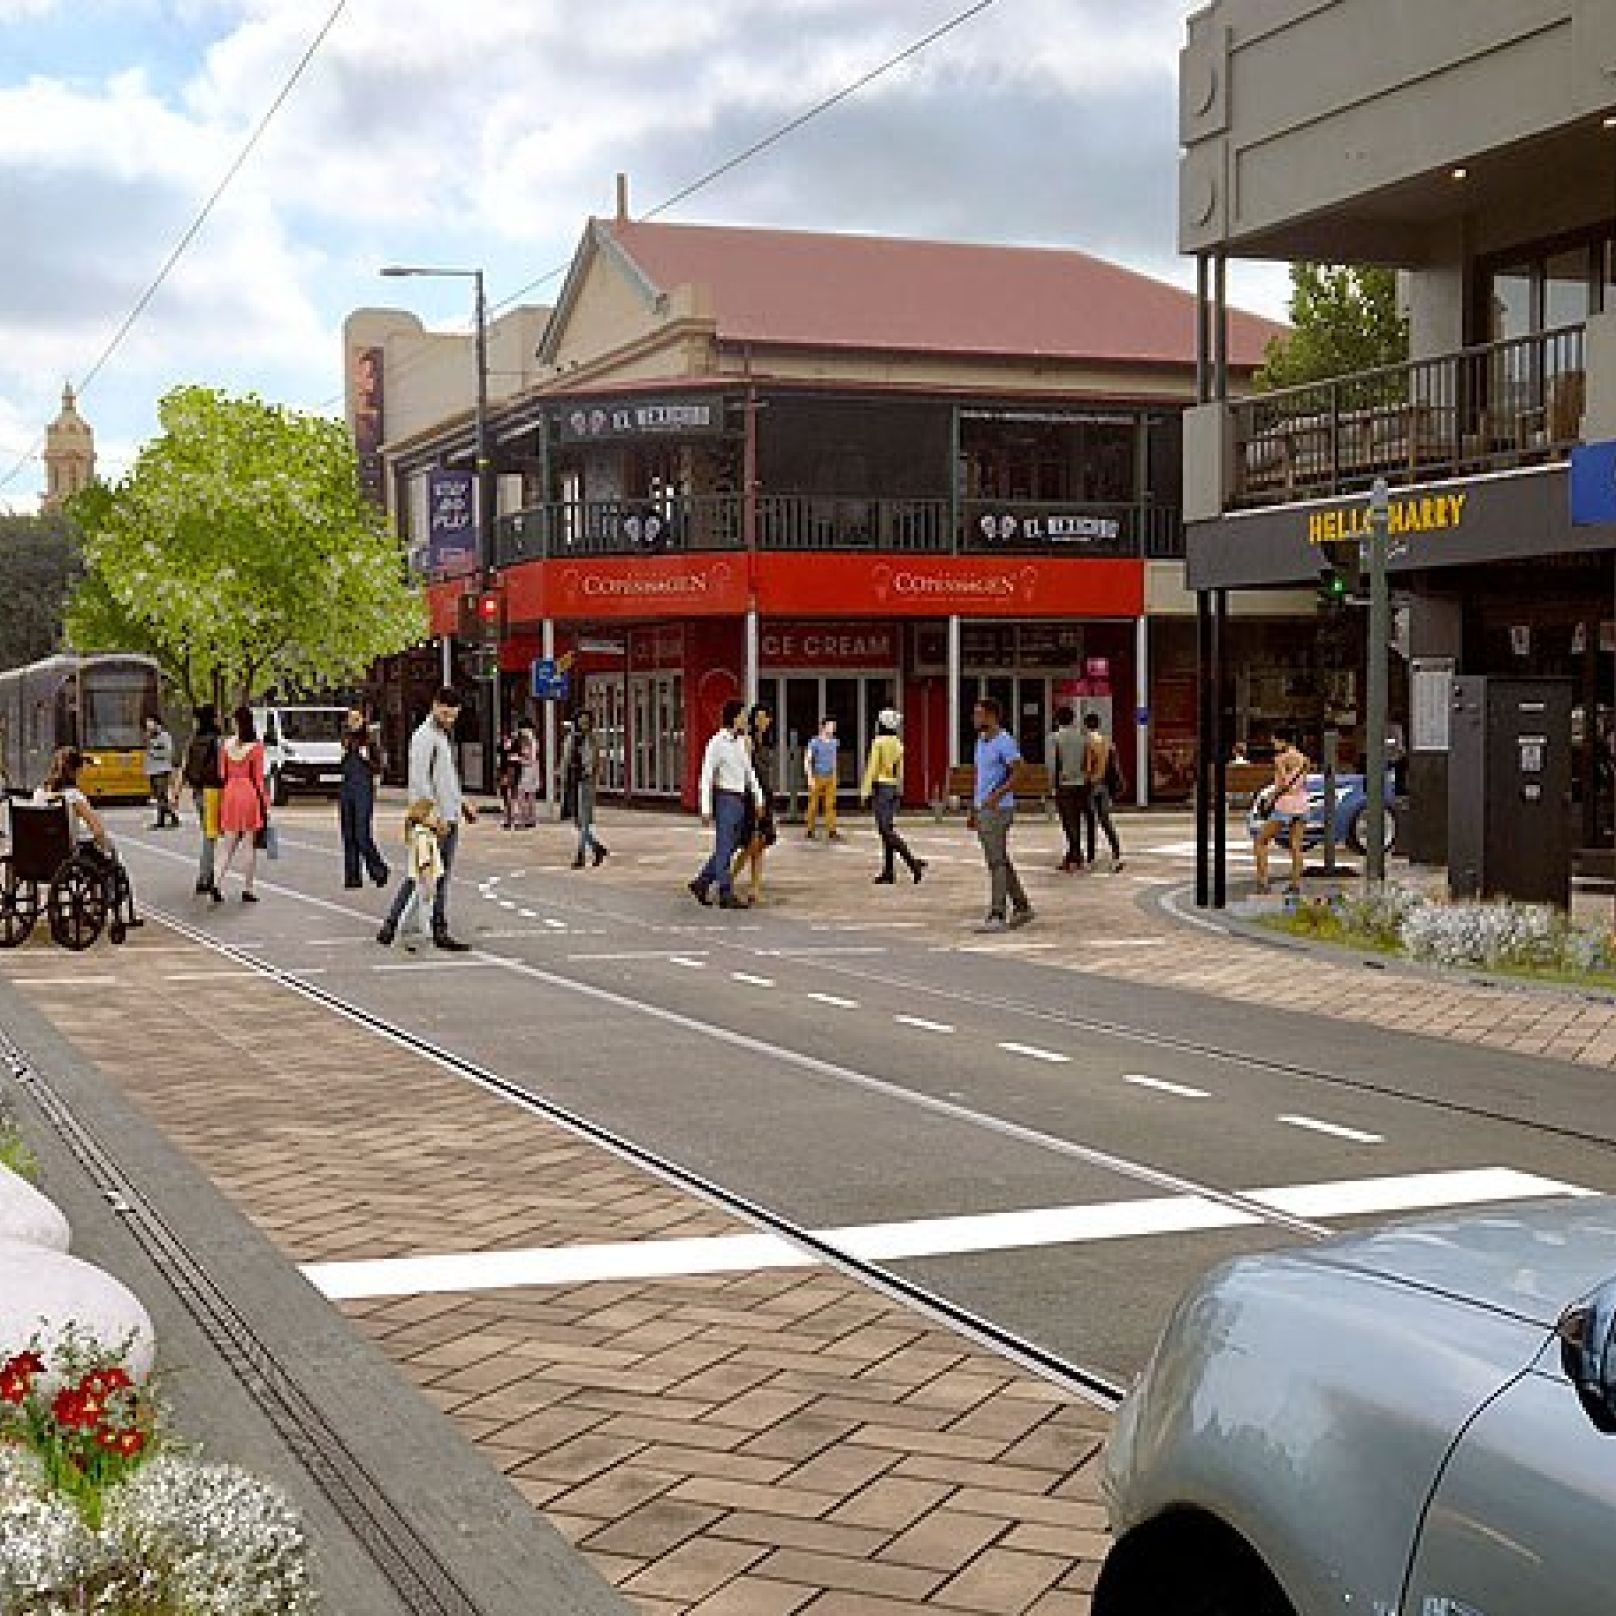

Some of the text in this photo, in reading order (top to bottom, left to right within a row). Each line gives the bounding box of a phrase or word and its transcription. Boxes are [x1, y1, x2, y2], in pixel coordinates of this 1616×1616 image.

[1387, 494, 1467, 535] HARRY
[761, 635, 891, 657] CE CREAM
